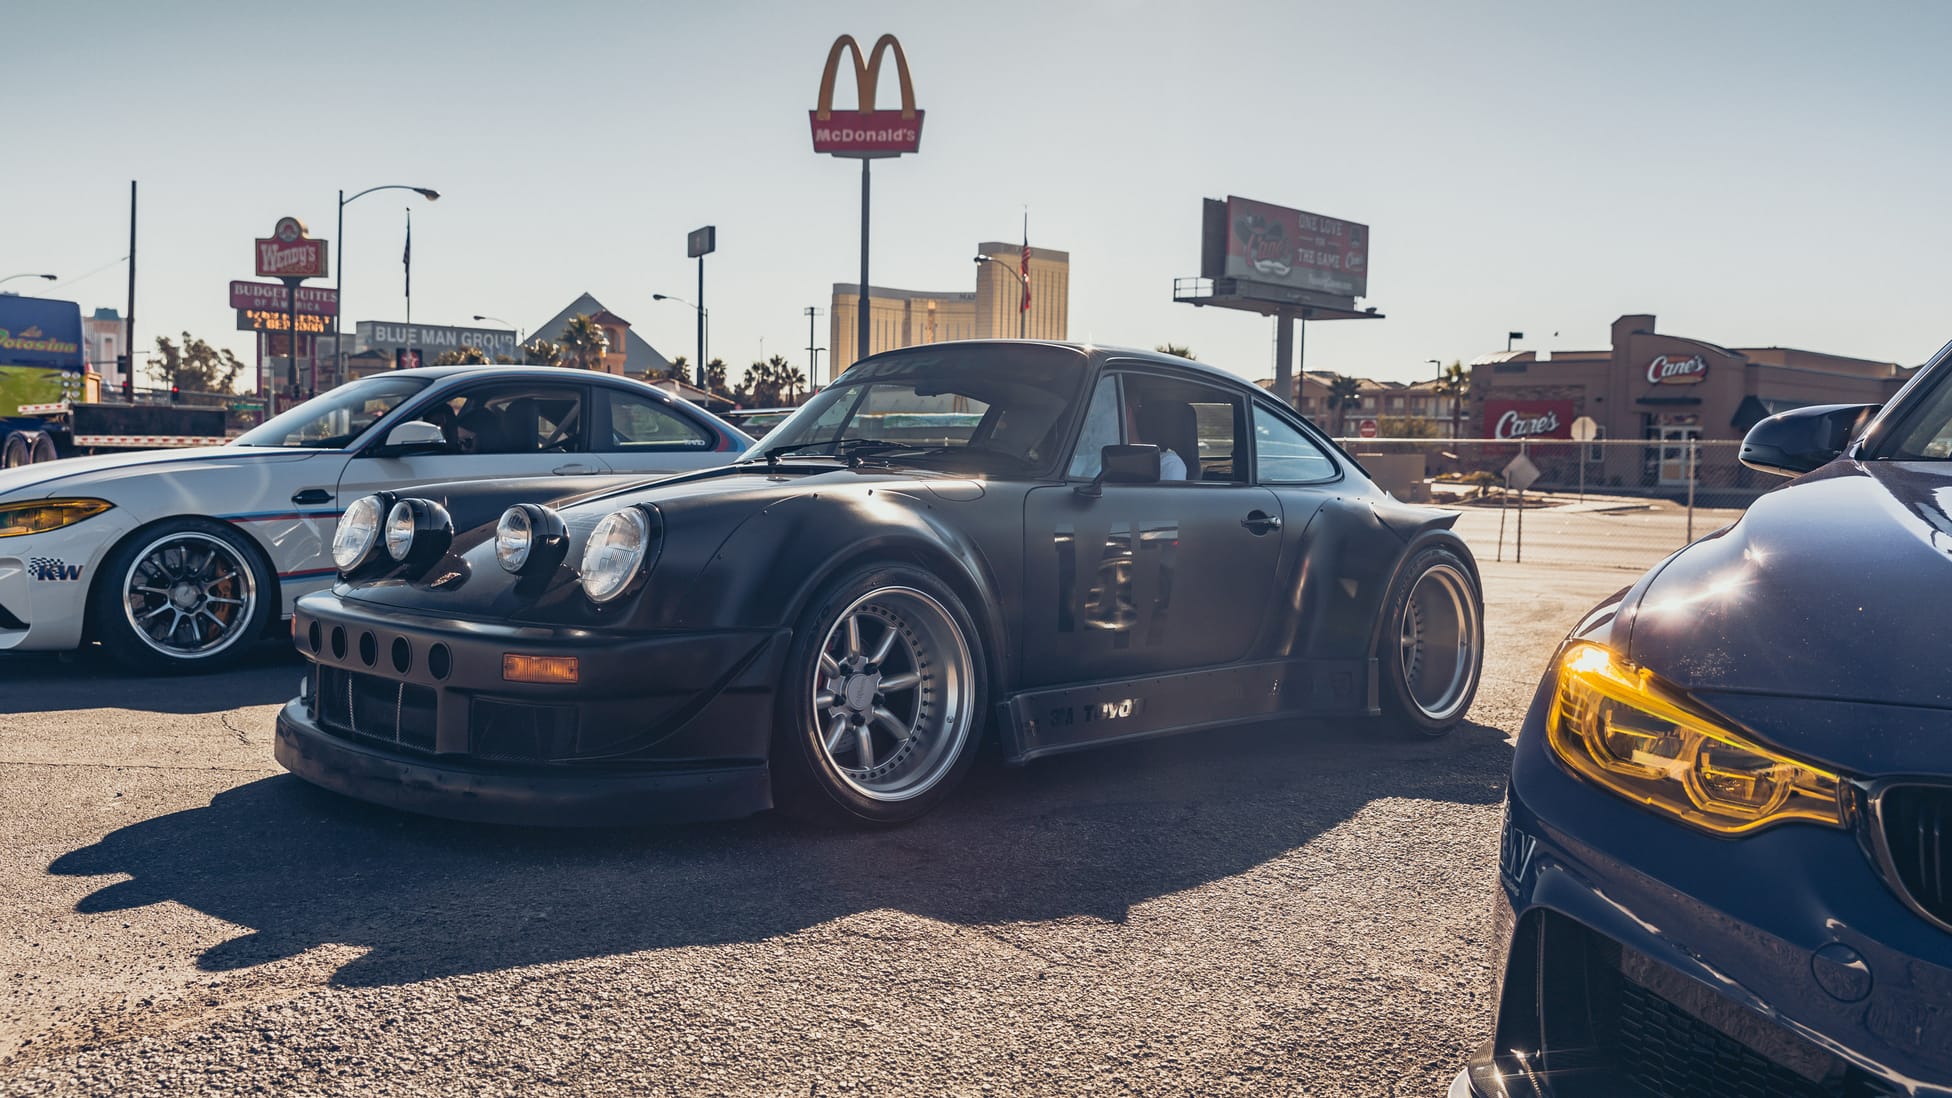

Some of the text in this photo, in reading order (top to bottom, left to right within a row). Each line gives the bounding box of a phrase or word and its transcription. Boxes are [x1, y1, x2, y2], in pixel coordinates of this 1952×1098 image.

[815, 128, 916, 142] McDonald's
[1298, 212, 1343, 236] ONE LOVE
[1297, 247, 1341, 269] THE GAME
[234, 284, 288, 299] BUDGET
[254, 298, 321, 311] OF AMRICA
[375, 326, 515, 349] BLUE MAN GROUP
[1647, 354, 1706, 384] Cane's
[1495, 409, 1560, 440] Cane's
[37, 564, 84, 581] KW
